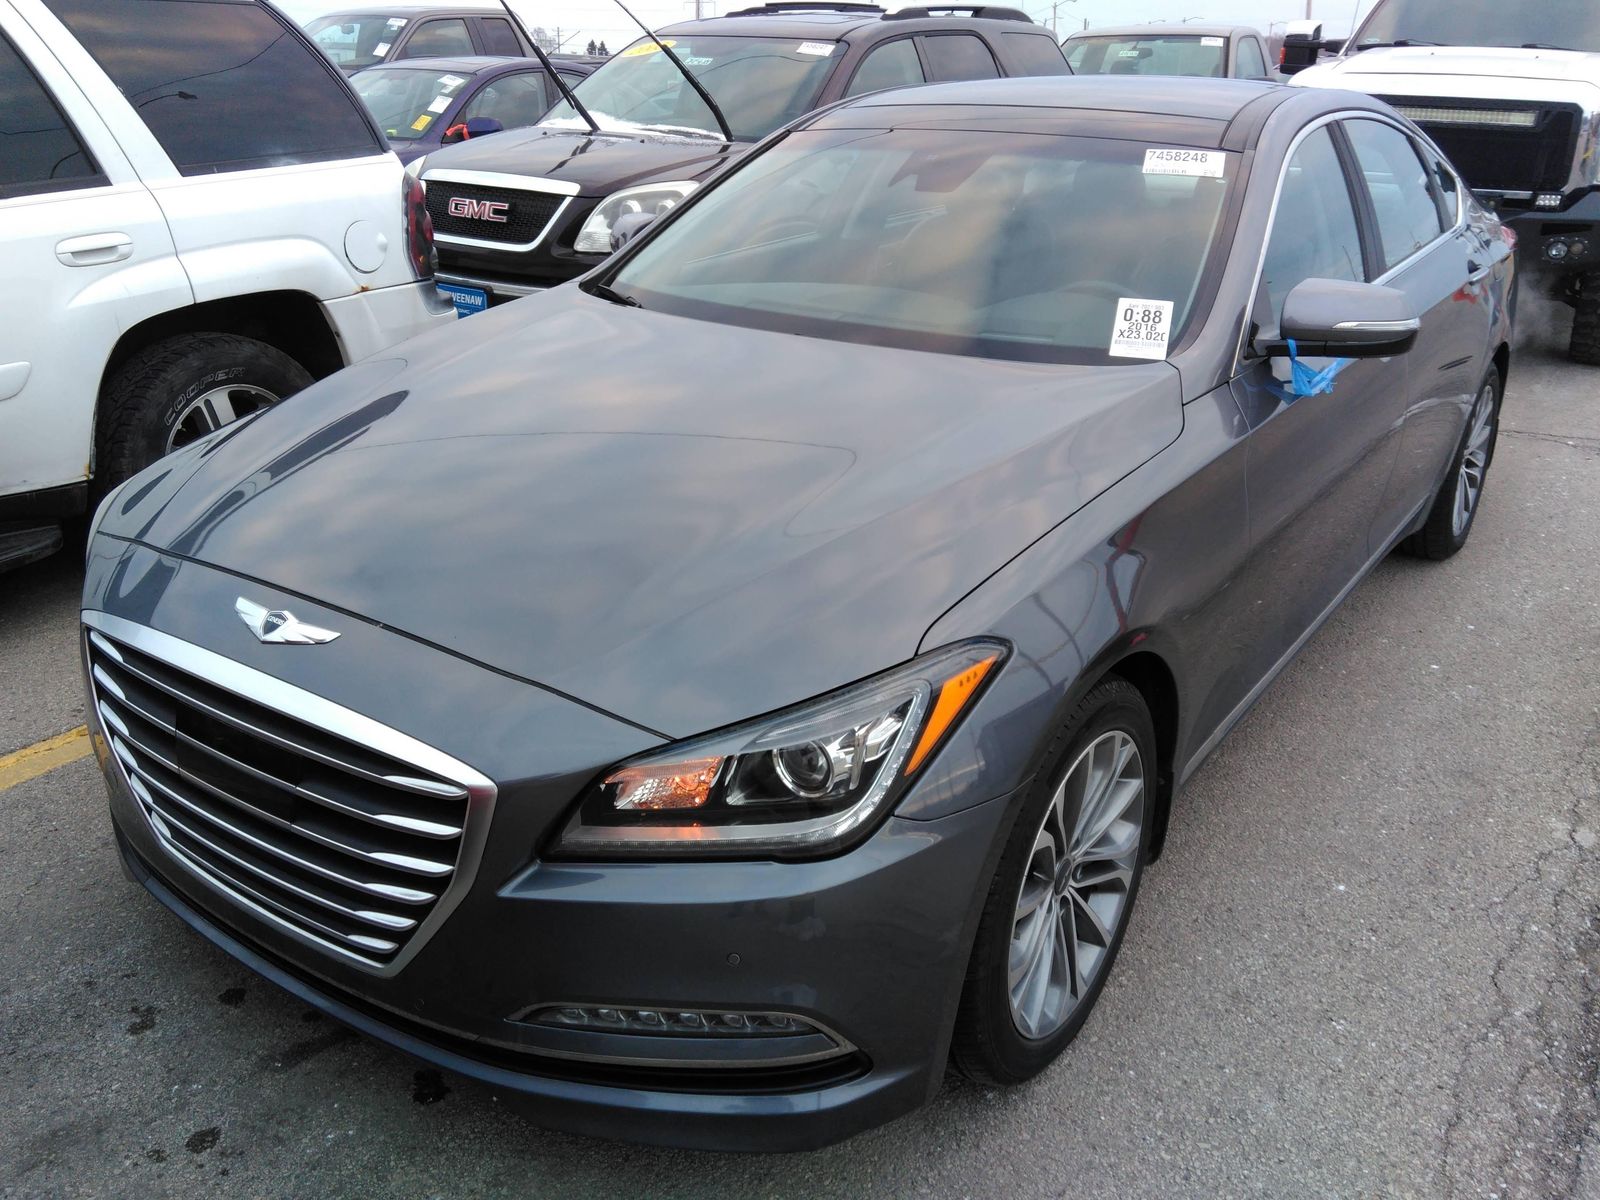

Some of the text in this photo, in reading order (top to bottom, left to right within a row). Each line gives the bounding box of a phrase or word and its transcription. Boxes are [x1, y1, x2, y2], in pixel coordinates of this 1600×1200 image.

[1148, 150, 1208, 163] 7458248
[448, 197, 509, 223] GMC
[1123, 307, 1163, 324] 0:88
[1127, 321, 1157, 332] 2016
[164, 367, 246, 426] COOPER
